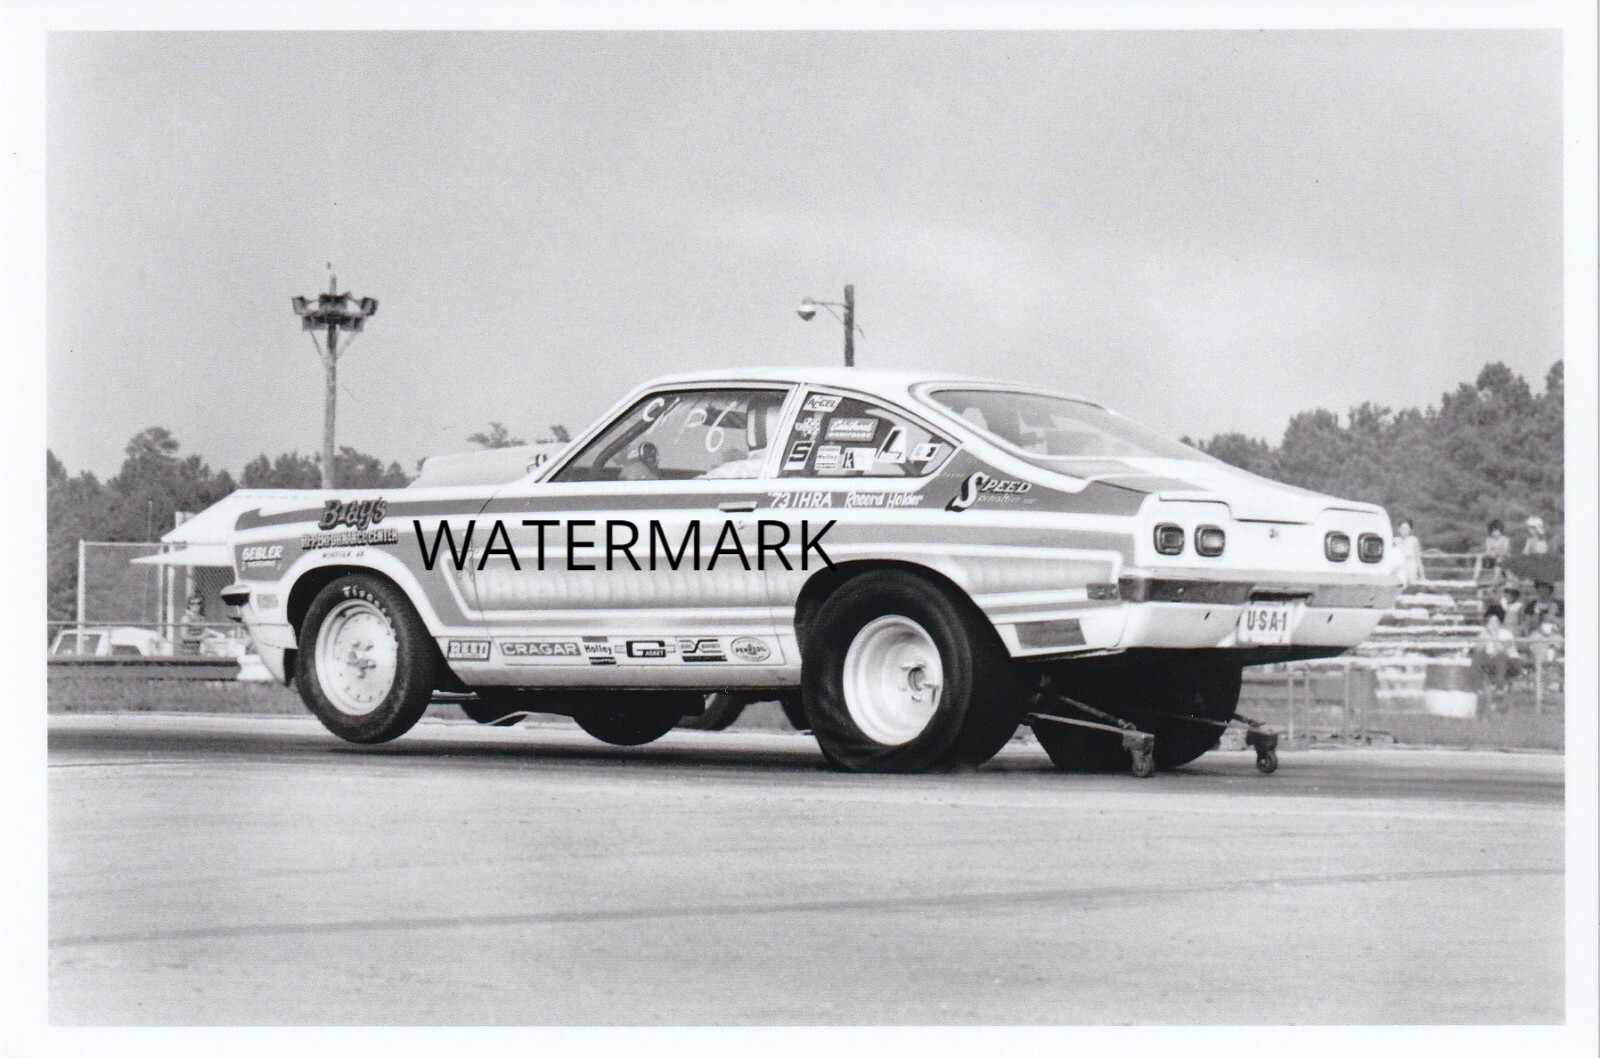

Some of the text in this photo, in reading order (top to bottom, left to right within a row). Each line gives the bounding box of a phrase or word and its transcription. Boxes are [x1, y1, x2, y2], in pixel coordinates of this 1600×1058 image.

[845, 492, 885, 508] Record
[886, 492, 924, 508] Holder
[502, 642, 577, 656] CRAGAR
[585, 644, 613, 655] Holley
